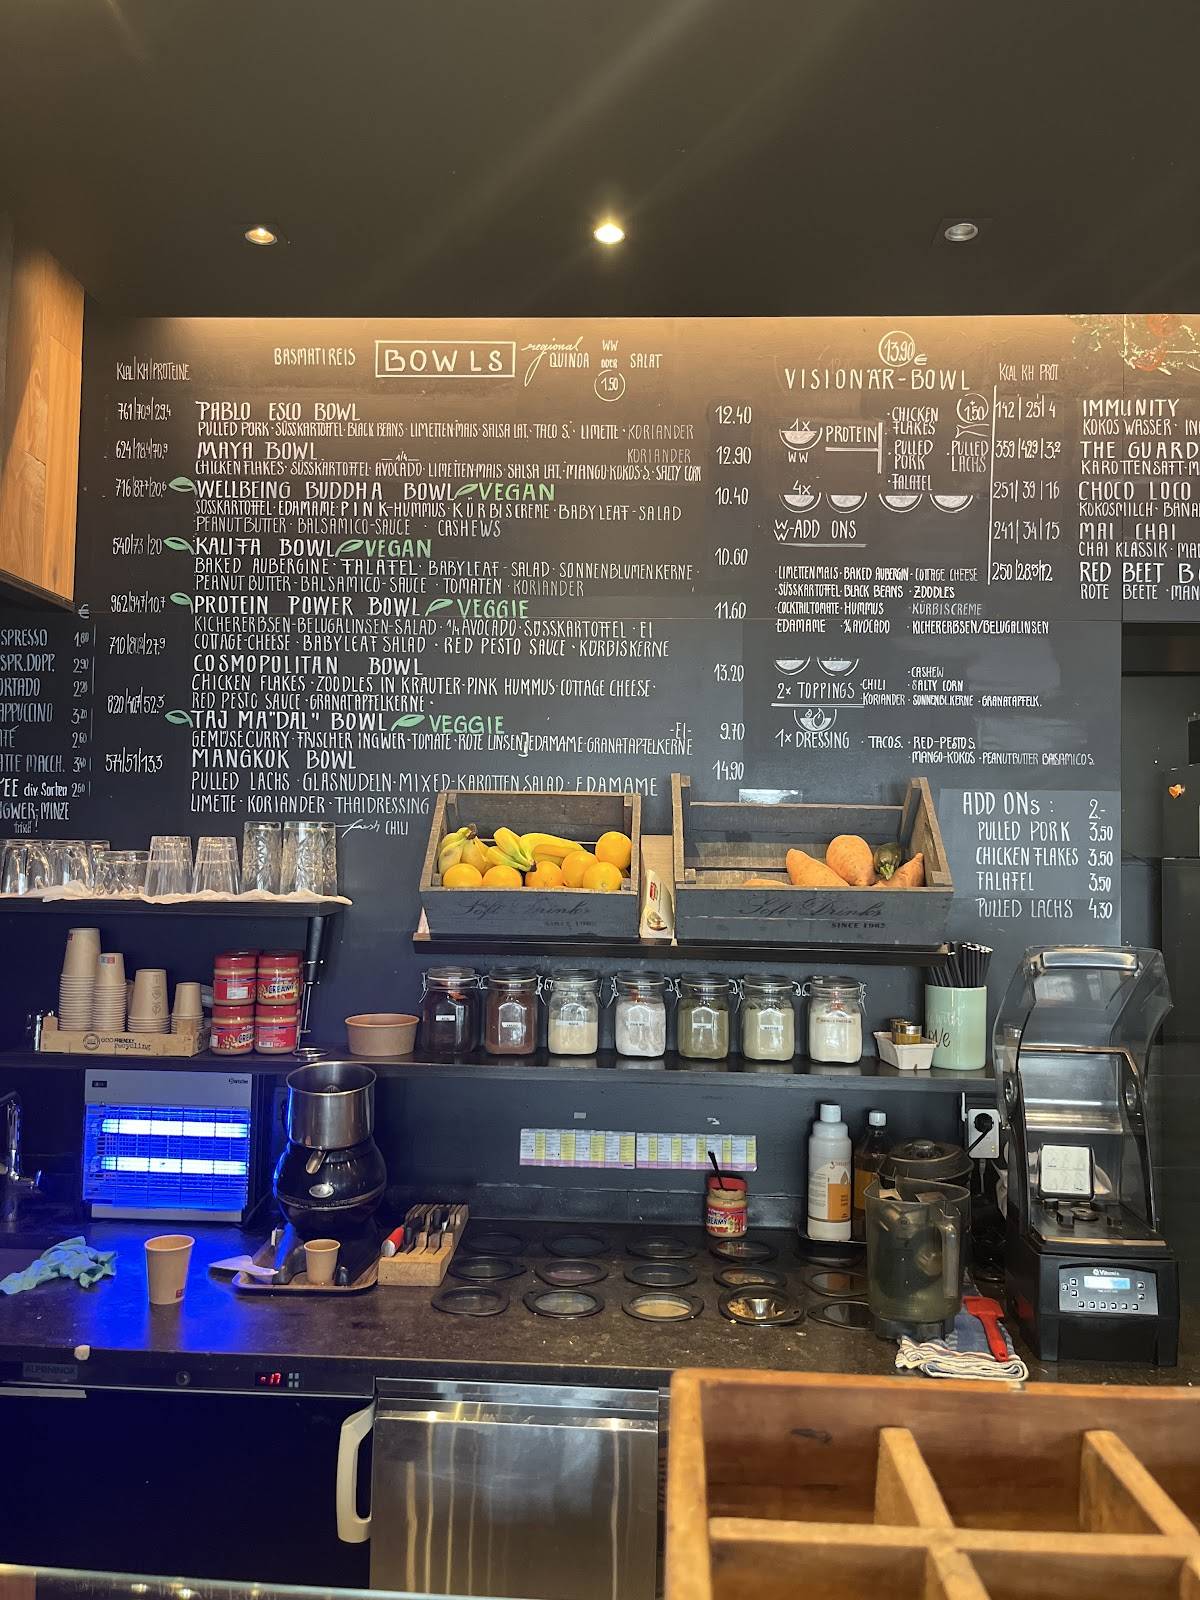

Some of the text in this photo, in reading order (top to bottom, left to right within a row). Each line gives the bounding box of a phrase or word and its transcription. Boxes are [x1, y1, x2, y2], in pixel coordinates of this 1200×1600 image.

[602, 340, 618, 350] WW
[385, 350, 503, 372] BOWLS
[522, 336, 583, 387] regional
[550, 352, 589, 368] QUINOA
[630, 353, 662, 368] SALAT
[1022, 364, 1058, 381] KH PROT
[601, 378, 618, 391] 1.50
[196, 401, 360, 421] PABLO ESCO BOWL
[715, 406, 751, 425] 12.40
[892, 407, 938, 422] CHICKEN
[1083, 399, 1179, 417] IMMUNITY
[198, 422, 694, 440] PULLED PORK BEANS SALSA TACO LIMETTE KORIANDER
[826, 426, 877, 442] PROTEIN
[893, 421, 935, 435] FLAKES
[1084, 419, 1172, 436] KOKOS WASSER
[197, 442, 317, 460] MAYA BOWL
[627, 449, 690, 463] KORIANDER
[716, 447, 751, 464] 12.90
[895, 440, 932, 455] PULLED
[952, 441, 988, 456] PULLED
[1080, 442, 1115, 459] THE
[196, 461, 241, 475] CHICKEN
[244, 461, 284, 475] FLAKES
[376, 462, 421, 476] AVOCADO
[508, 463, 539, 479] SALSA
[895, 455, 925, 470] PORK
[952, 456, 986, 472] LACHS
[196, 481, 555, 501] WELLBEING BUDDHA BOWL VEGAN
[715, 488, 748, 505] 10.40
[1079, 481, 1191, 500] CHOCO LOCO
[279, 501, 336, 515] EDAMAME
[1080, 503, 1153, 517] KOKOSMILCH
[438, 520, 501, 538] CASHEWS
[832, 520, 856, 539] ONS
[1080, 523, 1175, 540] MAI CHAI
[279, 538, 431, 558] BOWL VEGAN
[715, 548, 748, 566] 10.60
[1079, 542, 1167, 557] CHAI KLASSIK
[195, 558, 692, 580] BAKED AUBERGINE SONNENBLUMENKERNE
[844, 567, 978, 582] BAKED CHEESE
[1080, 562, 1164, 583] RED BEET
[443, 577, 584, 597] TOMATEN KORIANDER
[844, 585, 903, 598] BLACK BEANS
[1081, 584, 1158, 600] ROTE BEETE
[194, 595, 528, 619] PROTEIN POWER BOWL VEGGIE
[715, 602, 746, 619] 11.60
[844, 602, 884, 615] HUMMUS
[640, 622, 652, 638] EI
[776, 620, 825, 632] EDAMAME
[444, 637, 669, 658] RED PESTO SAUCE KÜRBISKERNE
[194, 655, 423, 676] COSMOPOLITAN BOWL
[714, 664, 744, 682] 13.20
[912, 667, 944, 678] CASHEW
[192, 674, 650, 697] CHICKEN FLAKES ZOODLES IN PINK HUMMUS COTTAGE CHEESE
[797, 679, 963, 699] TOPPINGS CHILI SALTY CORN
[192, 693, 424, 713] RED PESTO SAUCE GRANATAPFELKERNE
[862, 693, 905, 706] KORIANDER
[190, 711, 227, 729] TAJ
[331, 713, 387, 731] BOWL
[428, 715, 504, 734] VEGGIE
[720, 722, 745, 740] 9.70
[297, 732, 583, 753] FRISCHER INGWER TOMATE ROTE EDAMAME
[796, 731, 849, 749] DRESSING
[192, 750, 356, 769] MANGKOK BOWL
[713, 760, 744, 780] 14.90
[41, 781, 67, 797] Sorten
[192, 772, 392, 792] PULLED LACHS GLASNUDELN
[191, 795, 429, 814] LIMETTE KORIANDER THAIDRESSING
[963, 792, 1040, 815] ADD ONs
[386, 820, 408, 836] CHILI
[978, 821, 1113, 842] PULLED PORK 3.50
[976, 847, 1113, 866] CHICKEN FLAKES 3.50
[1088, 873, 1111, 892] 3.50
[975, 898, 1112, 919] PULLED LACHS 4.30
